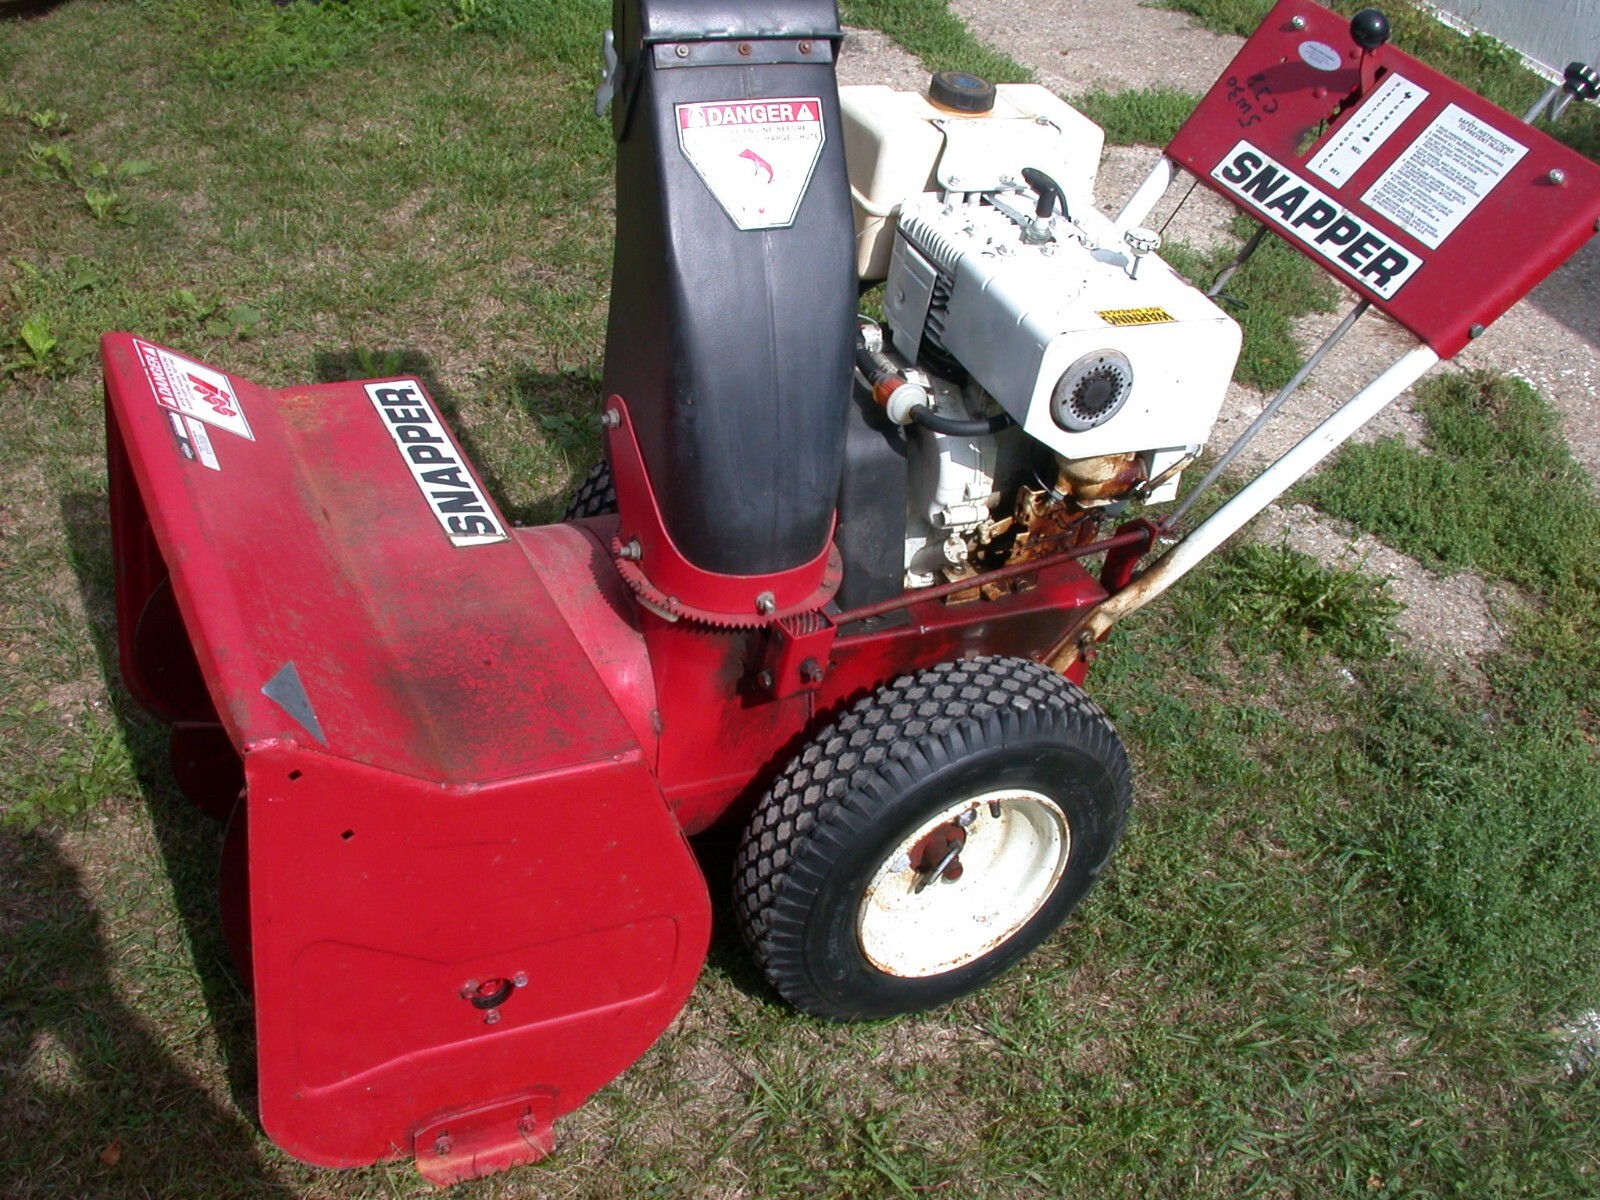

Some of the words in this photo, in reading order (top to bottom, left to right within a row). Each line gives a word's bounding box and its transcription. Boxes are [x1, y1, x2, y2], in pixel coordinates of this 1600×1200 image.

[707, 104, 794, 126] DANGER
[1356, 82, 1401, 128] DIRECTION
[1368, 99, 1405, 137] FORWARD
[1318, 131, 1354, 168] CONTROL
[1457, 117, 1477, 131] SAFETY
[1476, 129, 1514, 153] INSTRUCTIONS
[1464, 128, 1489, 144] PREVENT
[1222, 151, 1409, 288] SNAPPER
[145, 354, 172, 397] DANGER
[375, 388, 498, 535] SNAPPER
